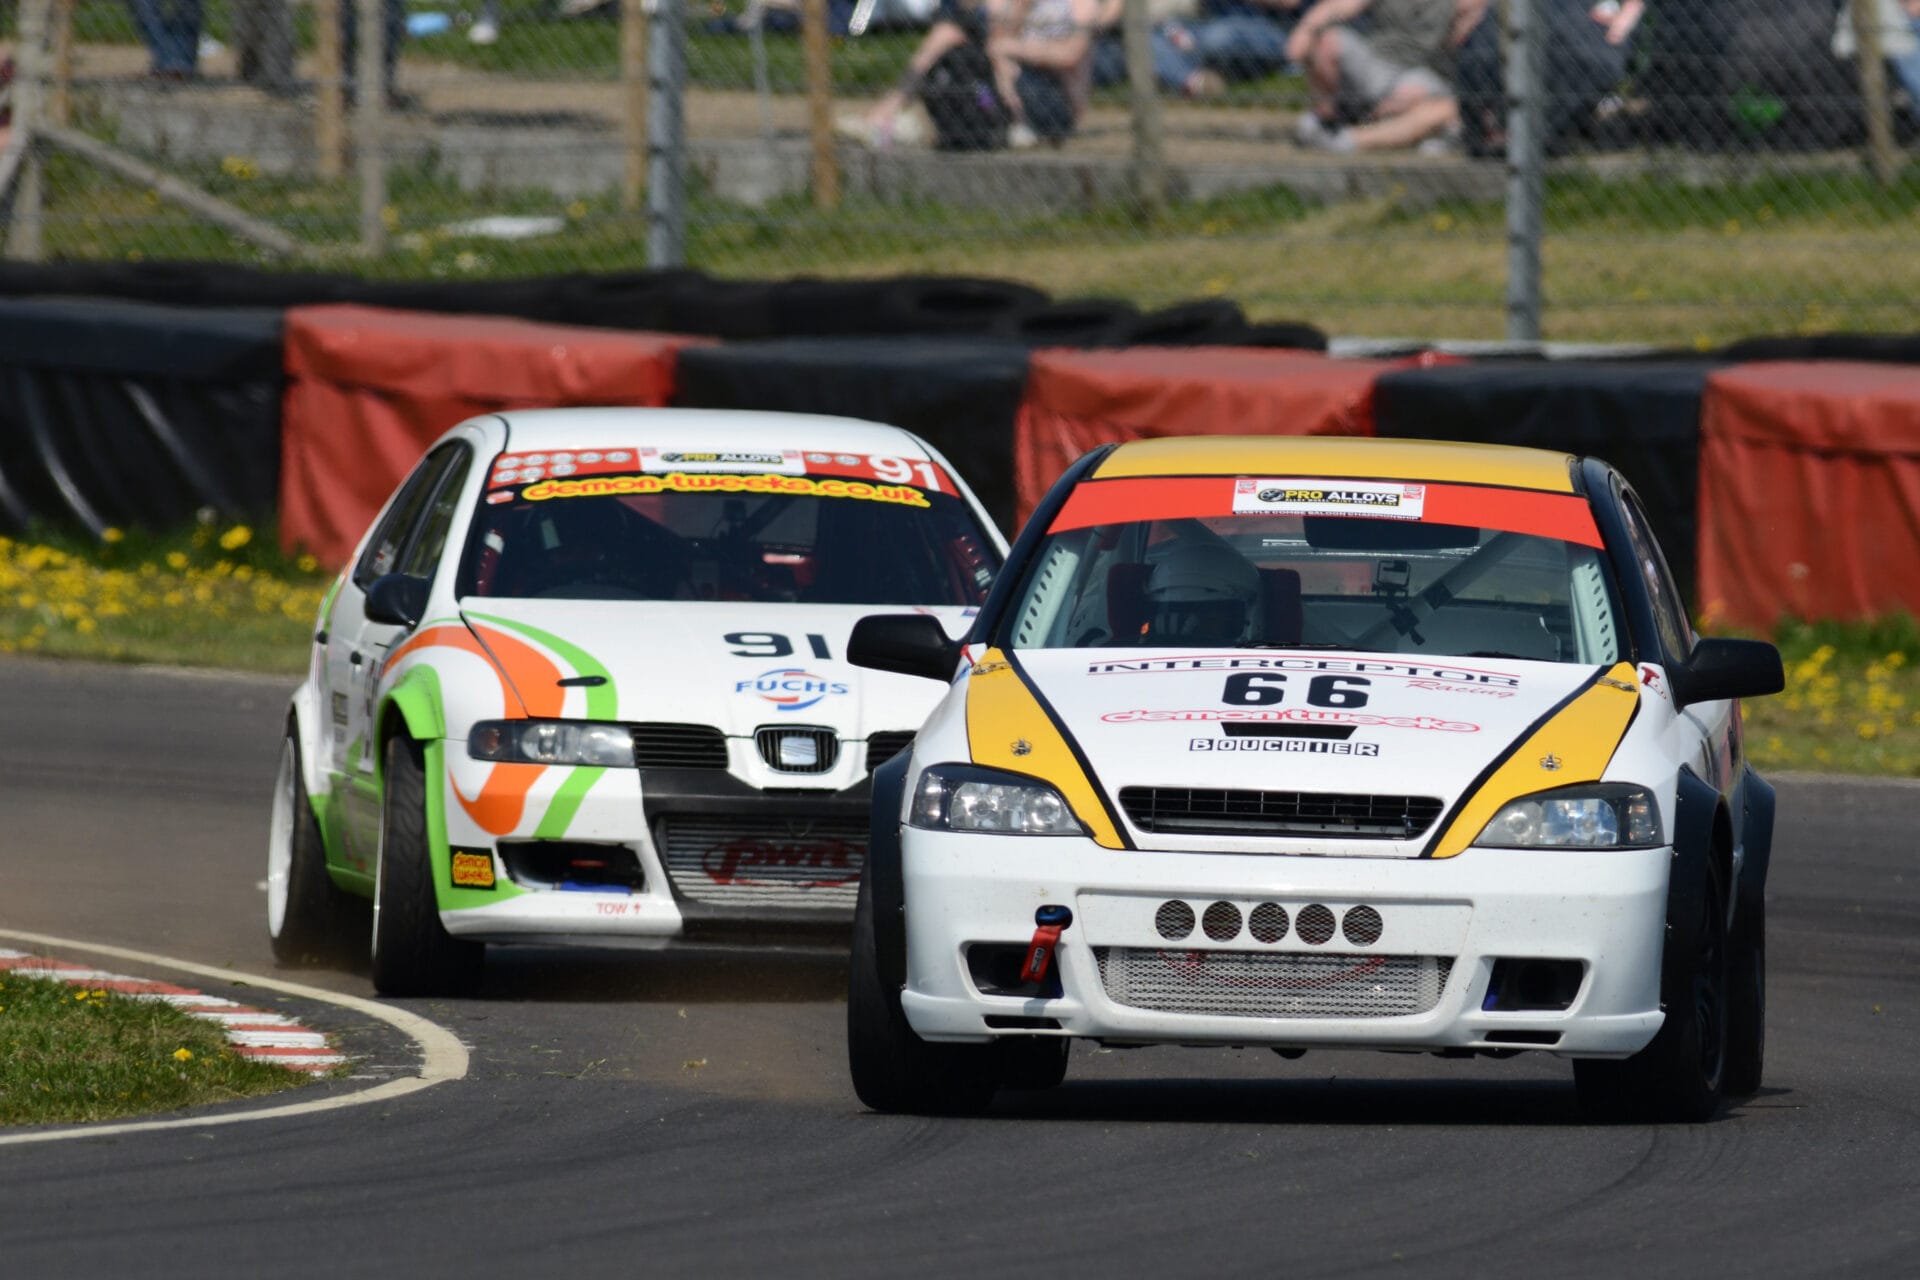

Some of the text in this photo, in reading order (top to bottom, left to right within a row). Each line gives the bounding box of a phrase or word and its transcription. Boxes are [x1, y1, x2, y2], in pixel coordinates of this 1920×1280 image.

[720, 453, 781, 464] ALLOYS
[868, 455, 942, 492] 91
[1285, 489, 1324, 500] PRO
[1327, 490, 1398, 503] ALLOYS
[723, 631, 833, 661] 91
[1089, 659, 1520, 687] INTERCEPTOR
[735, 680, 849, 696] FUCHS
[1222, 672, 1372, 710] 66
[1406, 680, 1516, 699] Racing
[1189, 738, 1380, 757] BOUCHIER
[595, 902, 628, 914] TOW
